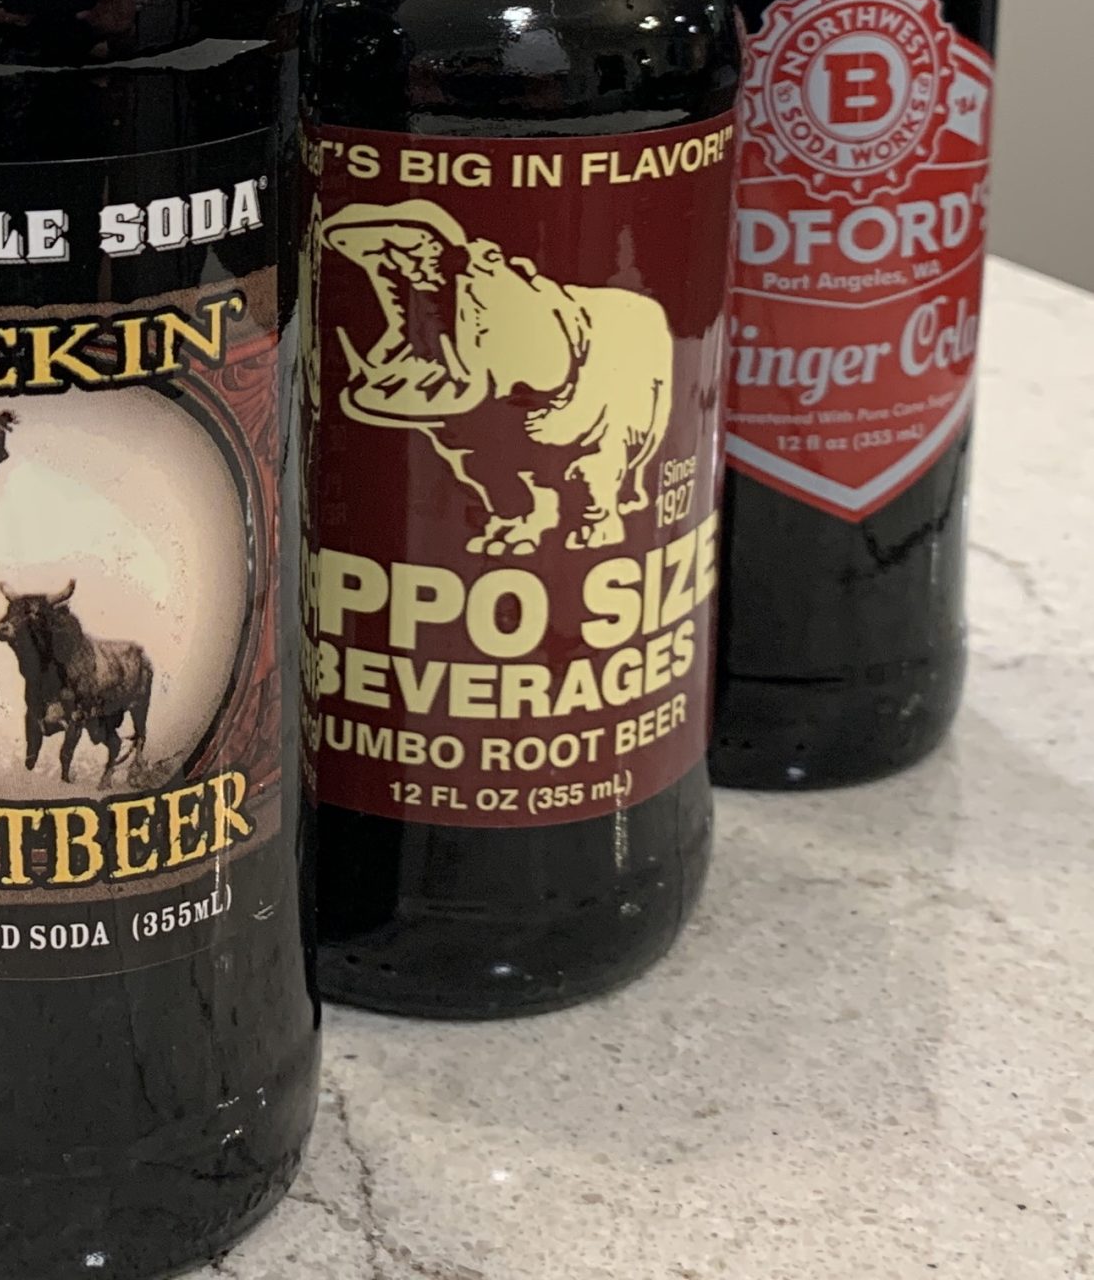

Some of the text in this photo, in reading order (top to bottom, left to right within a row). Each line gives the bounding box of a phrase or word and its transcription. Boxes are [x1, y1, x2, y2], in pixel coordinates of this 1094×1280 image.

[780, 6, 930, 76] NORTHWEST
[823, 52, 894, 124] B
[781, 99, 927, 166] SODA WORKS
[400, 150, 492, 187] BIG
[512, 154, 562, 188] IN
[99, 179, 266, 259] SODA
[762, 271, 810, 291] Port
[913, 259, 941, 280] WA
[733, 318, 891, 406] inger
[663, 456, 697, 487] Since
[776, 435, 801, 452] 12
[655, 479, 696, 528] 1927
[581, 509, 718, 650] SIZE
[481, 729, 606, 771] ROOT
[615, 693, 687, 756] BEER
[389, 769, 633, 815] 12 FL OZ (355 mL)
[29, 920, 110, 951] SODA
